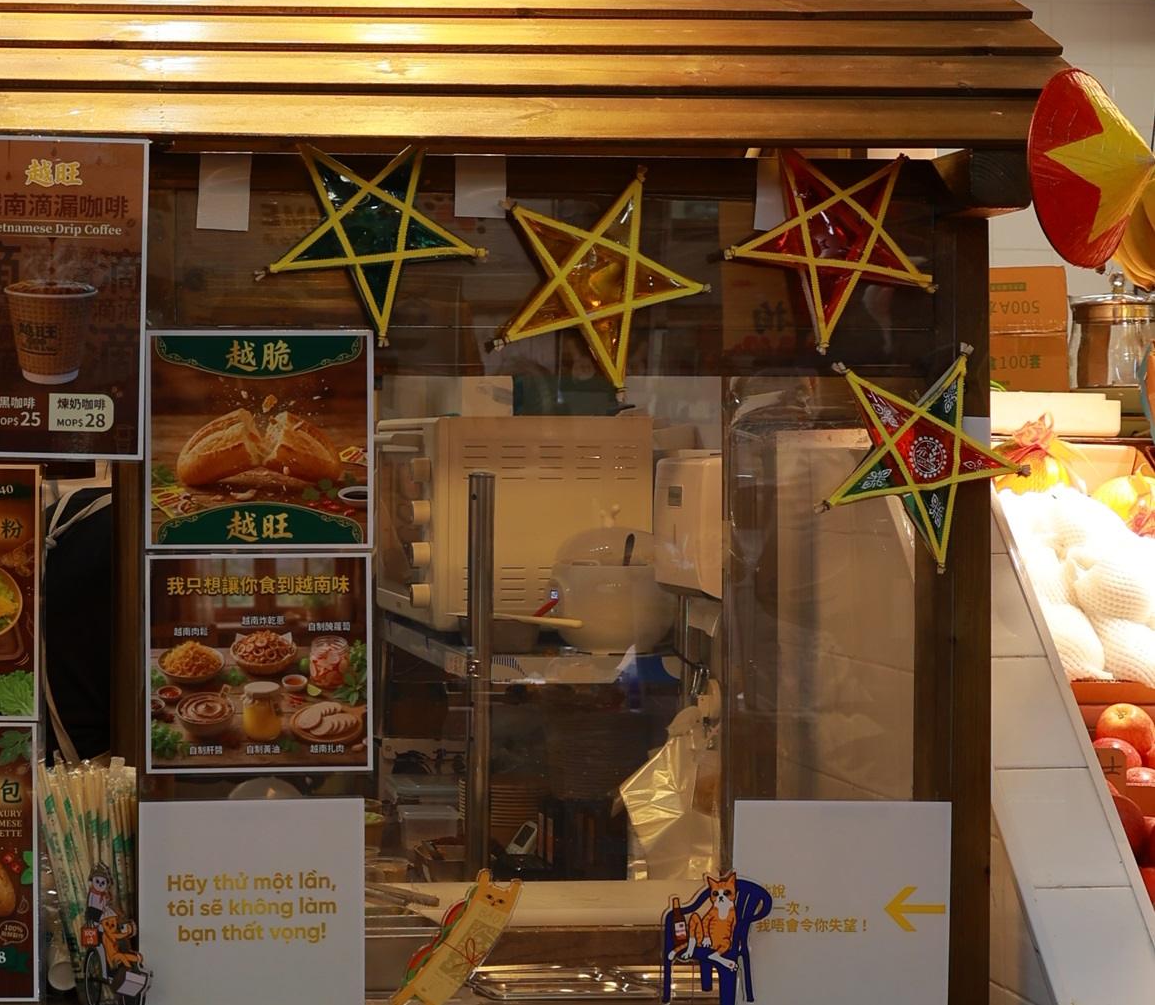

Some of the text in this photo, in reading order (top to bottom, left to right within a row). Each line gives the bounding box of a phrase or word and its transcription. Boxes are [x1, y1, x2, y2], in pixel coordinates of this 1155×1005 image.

[25, 159, 83, 187] 越旺
[54, 223, 82, 238] Drip
[84, 223, 122, 236] Coffee
[224, 339, 294, 374] 越脆
[20, 410, 41, 427] 25
[56, 413, 106, 429] MOP$ 28
[225, 510, 294, 544] 越旺
[166, 575, 350, 596] 我只想讓你食到越南味
[167, 871, 337, 896] Hãy thử một lần,
[167, 897, 337, 922] tôi sẽ không làm
[177, 921, 328, 947] bạn thất vọng!
[755, 918, 868, 933] 我唔會令你失望！
